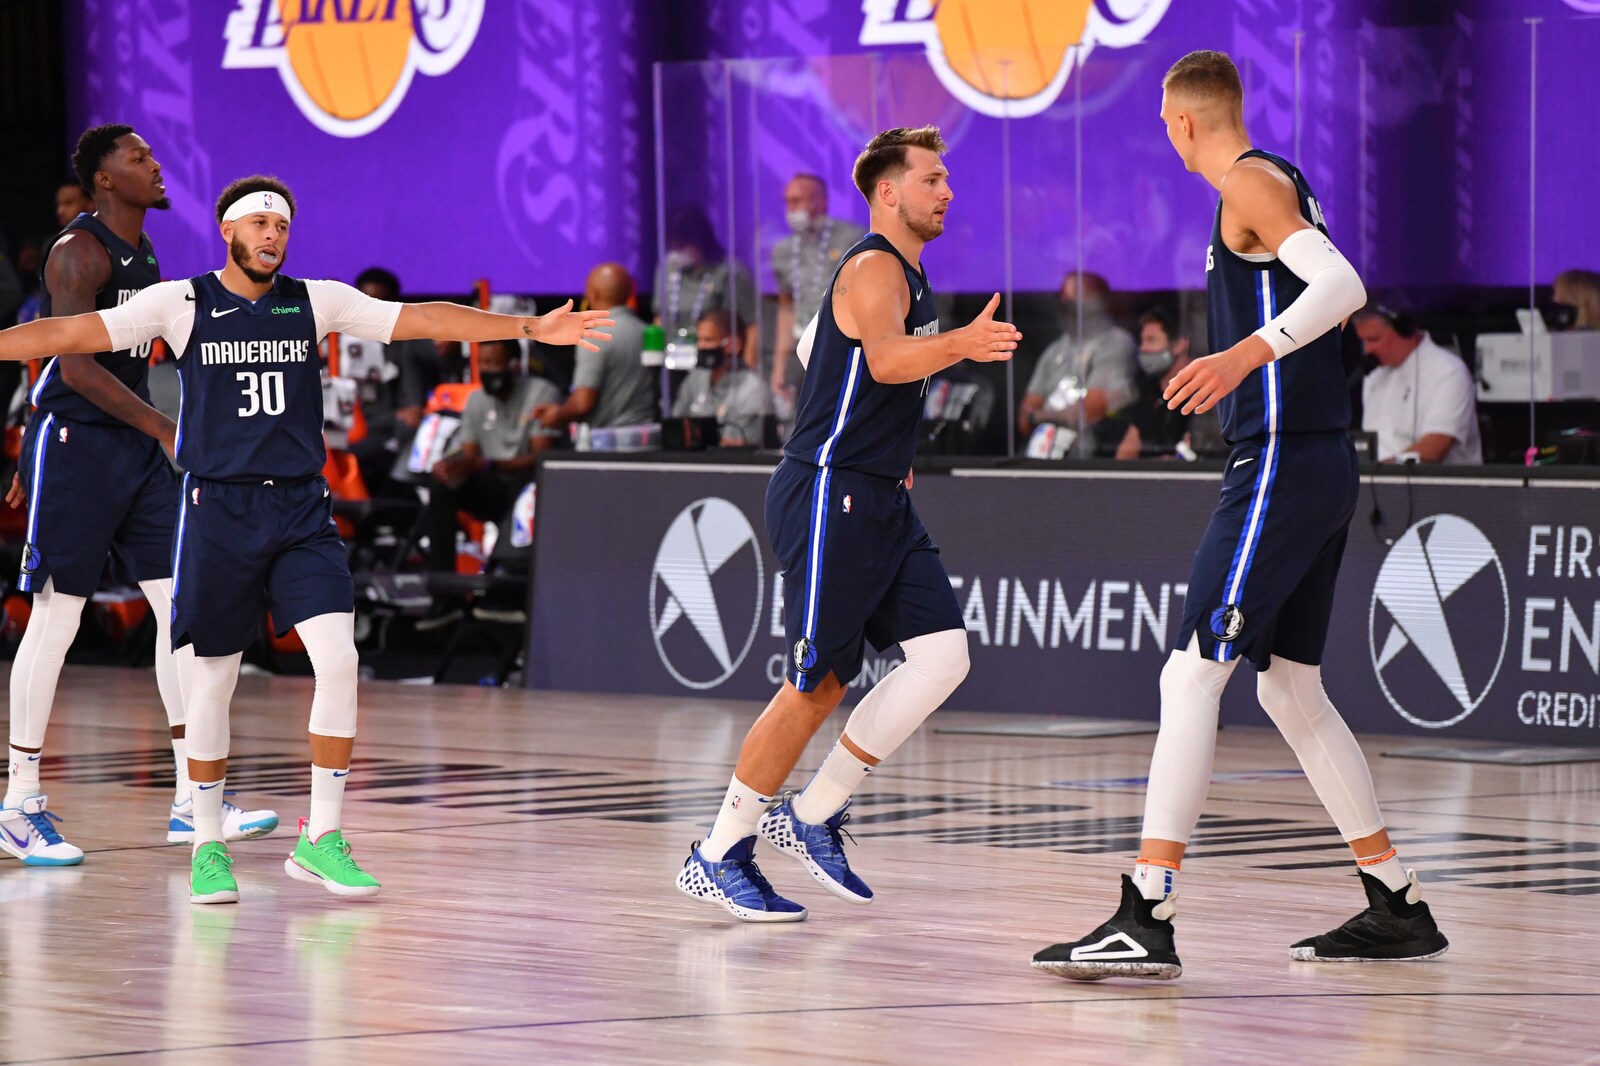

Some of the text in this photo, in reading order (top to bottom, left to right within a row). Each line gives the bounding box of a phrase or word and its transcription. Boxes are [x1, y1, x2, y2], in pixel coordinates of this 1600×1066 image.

[271, 306, 301, 315] chime
[200, 340, 309, 365] MAVERICKS
[236, 371, 286, 417] 30
[1527, 524, 1600, 579] FIR
[1517, 689, 1600, 728] CREDI
